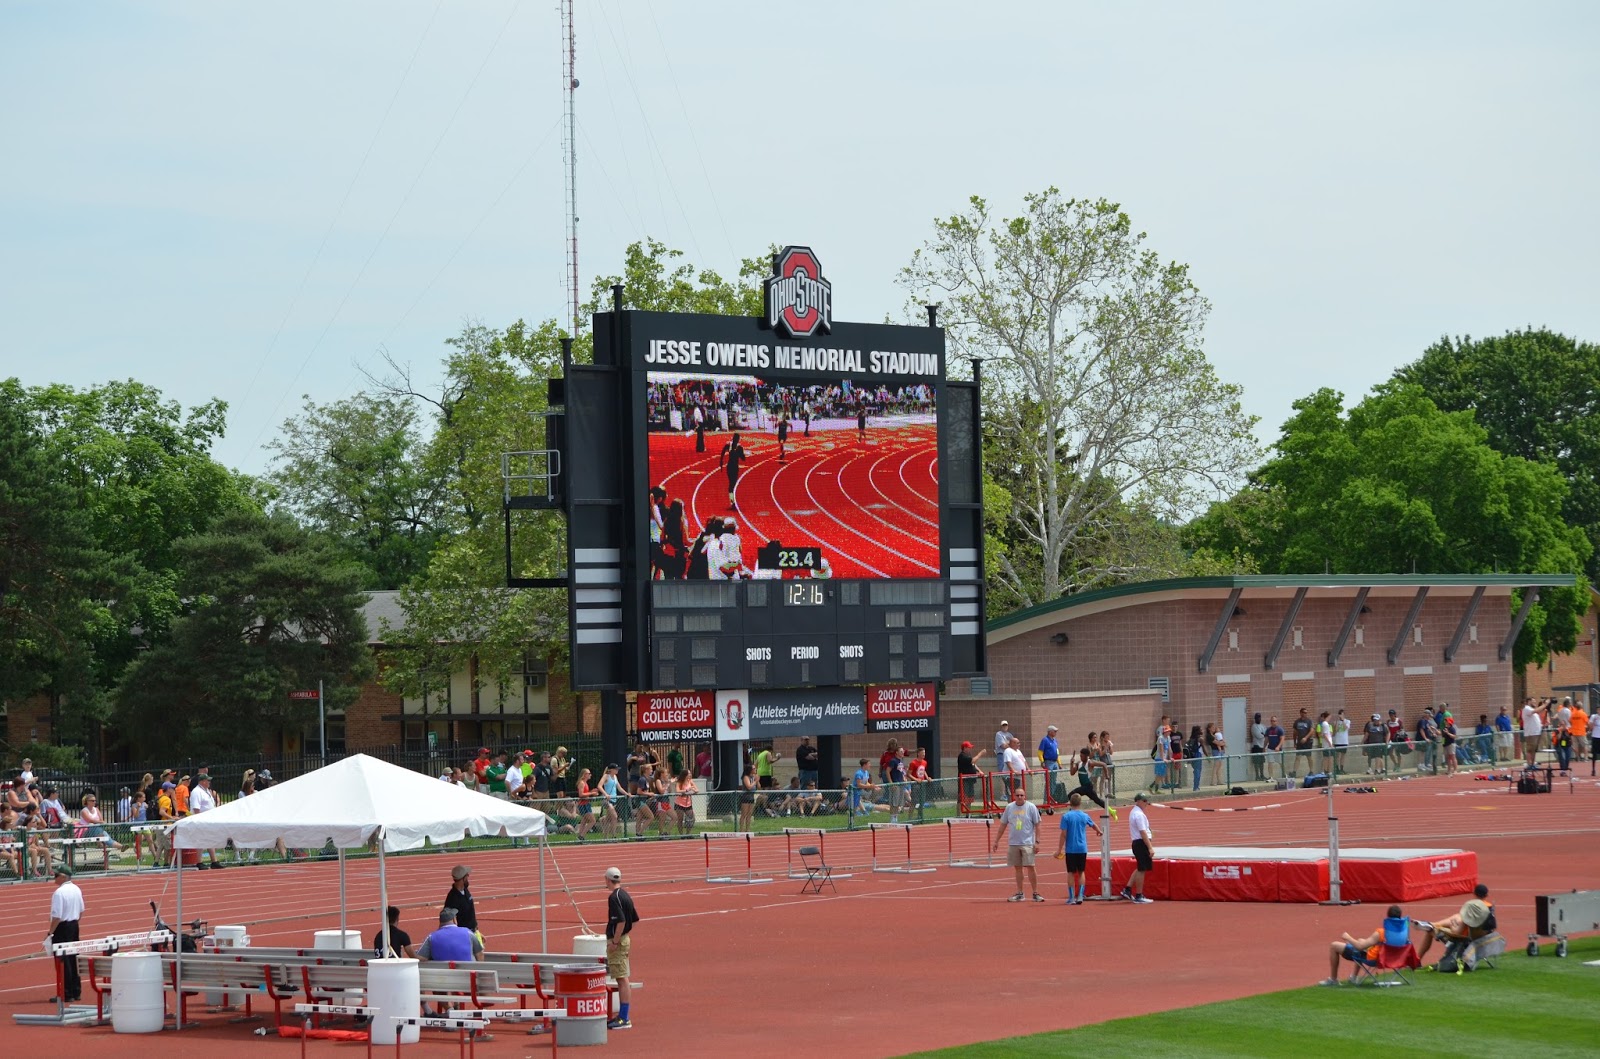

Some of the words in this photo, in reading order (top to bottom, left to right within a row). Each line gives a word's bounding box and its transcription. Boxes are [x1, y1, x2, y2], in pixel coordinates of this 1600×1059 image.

[644, 339, 702, 365] JESSE
[706, 342, 770, 368] OWENS
[775, 345, 866, 373] MEMORIAL
[869, 350, 939, 376] STADIUM
[778, 550, 814, 567] 23.4
[789, 583, 823, 605] 12:16
[746, 647, 772, 661] SHOTS
[791, 646, 819, 660] PERIOD
[839, 645, 864, 658] SHOTS
[878, 689, 898, 701] 2007
[900, 688, 926, 699] NCAA
[650, 698, 672, 710] 2010
[674, 697, 703, 708] NCAA
[872, 701, 912, 714] COLLEGE
[913, 700, 932, 712] CUP
[643, 710, 688, 724] COLLEGE
[689, 709, 711, 722] CUP
[752, 704, 788, 719] Athletes
[790, 703, 823, 720] Helping
[876, 720, 900, 731] MEN'S
[900, 718, 929, 729] SOCCER
[641, 729, 680, 741] WOMEN'S
[681, 728, 713, 740] SOCCER
[1203, 865, 1240, 876] UCS
[1430, 859, 1451, 872] UCS
[425, 1019, 447, 1027] UCS
